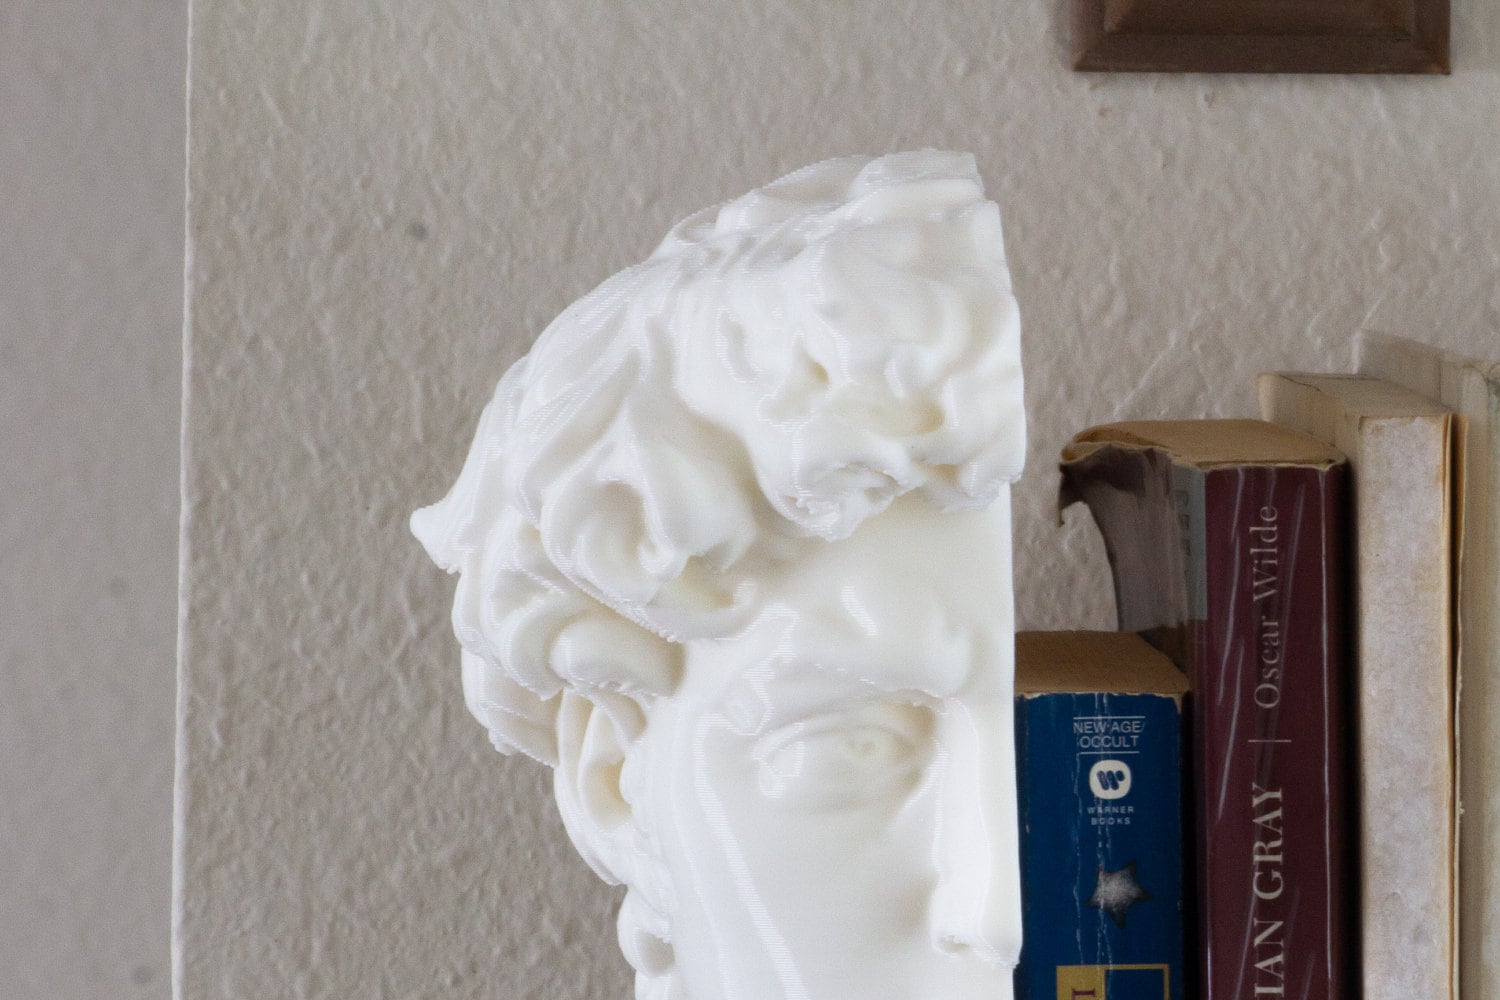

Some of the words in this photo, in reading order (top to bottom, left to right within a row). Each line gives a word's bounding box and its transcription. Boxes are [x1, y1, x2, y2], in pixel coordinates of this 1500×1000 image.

[1249, 504, 1279, 603] Wilde
[1253, 615, 1281, 710] Oscar
[1080, 736, 1139, 748] OCCULT
[1087, 806, 1134, 814] WARNER
[1251, 781, 1285, 901] GRAY
